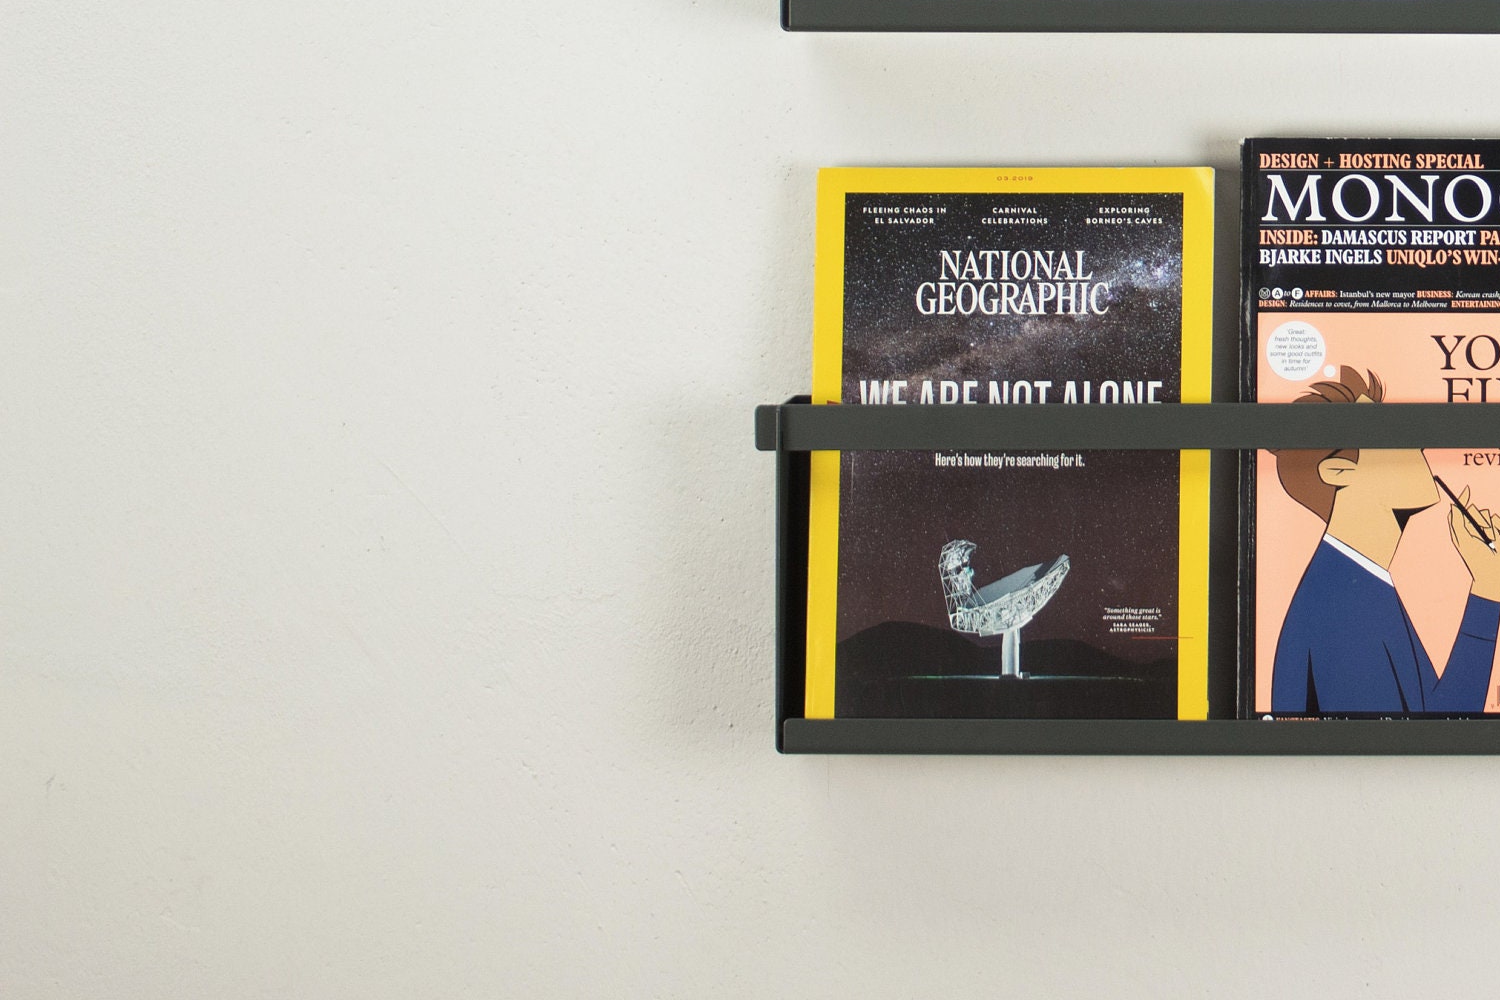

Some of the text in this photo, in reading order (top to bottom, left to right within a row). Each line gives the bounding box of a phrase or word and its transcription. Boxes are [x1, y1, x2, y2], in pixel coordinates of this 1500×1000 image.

[1259, 153, 1319, 168] DESIGN
[1340, 154, 1411, 168] HOSTING
[1416, 154, 1484, 168] SPECIAL
[862, 206, 899, 214] FLEEING
[903, 206, 933, 214] CHAOS
[981, 217, 1047, 226] CELEBRATIONS
[1086, 217, 1162, 225] BORNEO'S CAVES
[1260, 230, 1317, 245] INSIDE:
[1322, 230, 1407, 245] DAMASCUS
[1411, 230, 1476, 245] REPORT
[939, 249, 1092, 280] NATIONAL
[1260, 249, 1321, 267] BJARKE
[1325, 249, 1382, 264] INGELS
[1386, 250, 1461, 268] UNIQLO'S
[915, 281, 1110, 315] GEOGRAPHIC
[1304, 289, 1337, 298] AFFAIRS:
[1339, 290, 1374, 298] Istanbul's
[1392, 292, 1415, 300] mayor
[1416, 290, 1453, 299] BUSINESS:
[1455, 290, 1480, 298] Korean
[934, 453, 1085, 469] Here's how they're searching for it.
[1138, 607, 1154, 615] great
[1155, 607, 1161, 616] is
